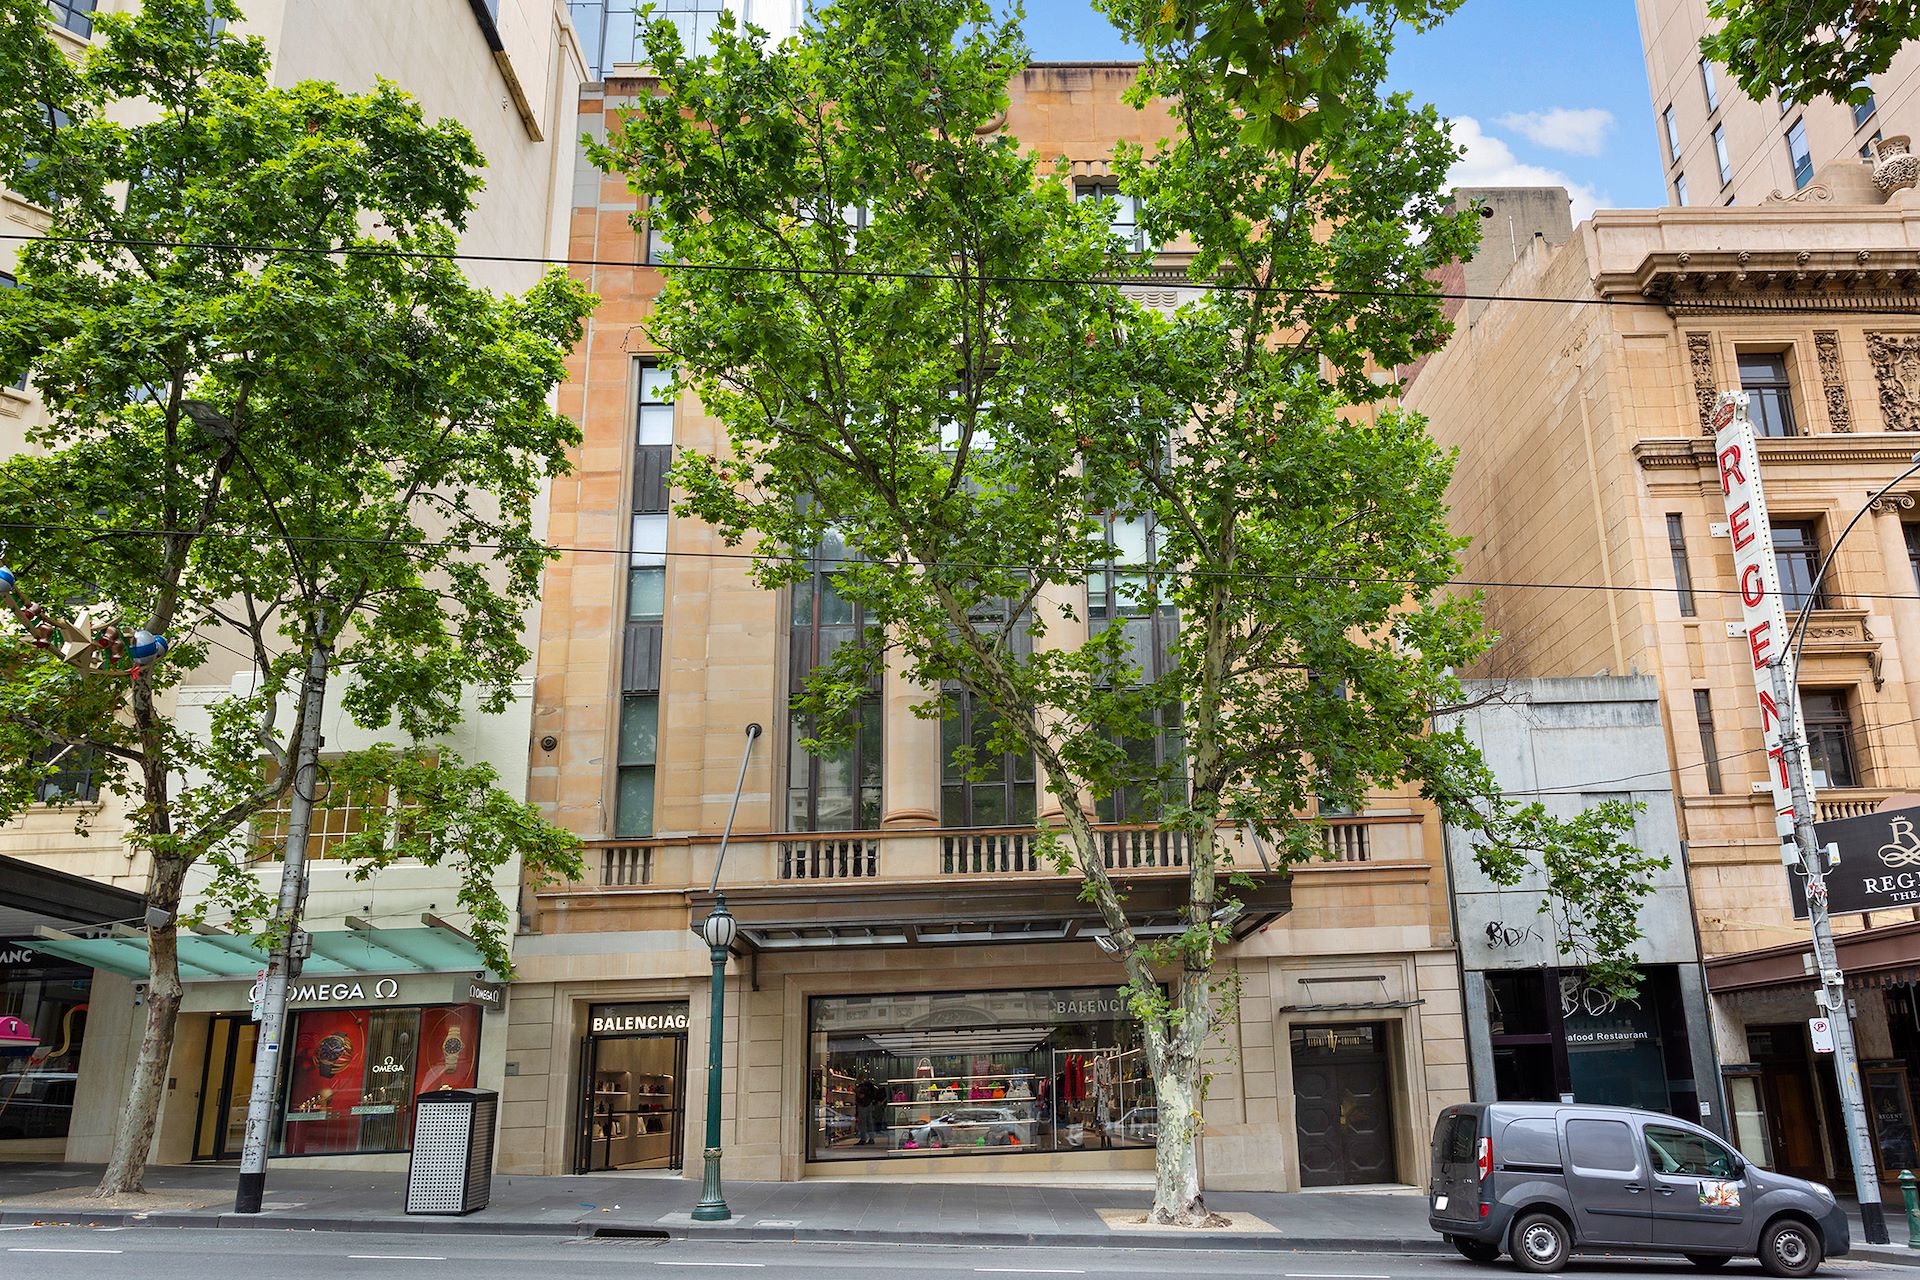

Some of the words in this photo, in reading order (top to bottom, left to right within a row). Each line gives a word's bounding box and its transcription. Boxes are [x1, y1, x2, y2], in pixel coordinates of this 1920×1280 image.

[1719, 444, 1790, 790] REGENT
[475, 988, 493, 1000] OMEGA
[1056, 999, 1132, 1014] BALENCI
[592, 1014, 691, 1032] BALENCIAG
[1565, 1033, 1594, 1042] afood
[1596, 1031, 1648, 1041] Restaurant
[372, 1064, 405, 1073] OMEGA
